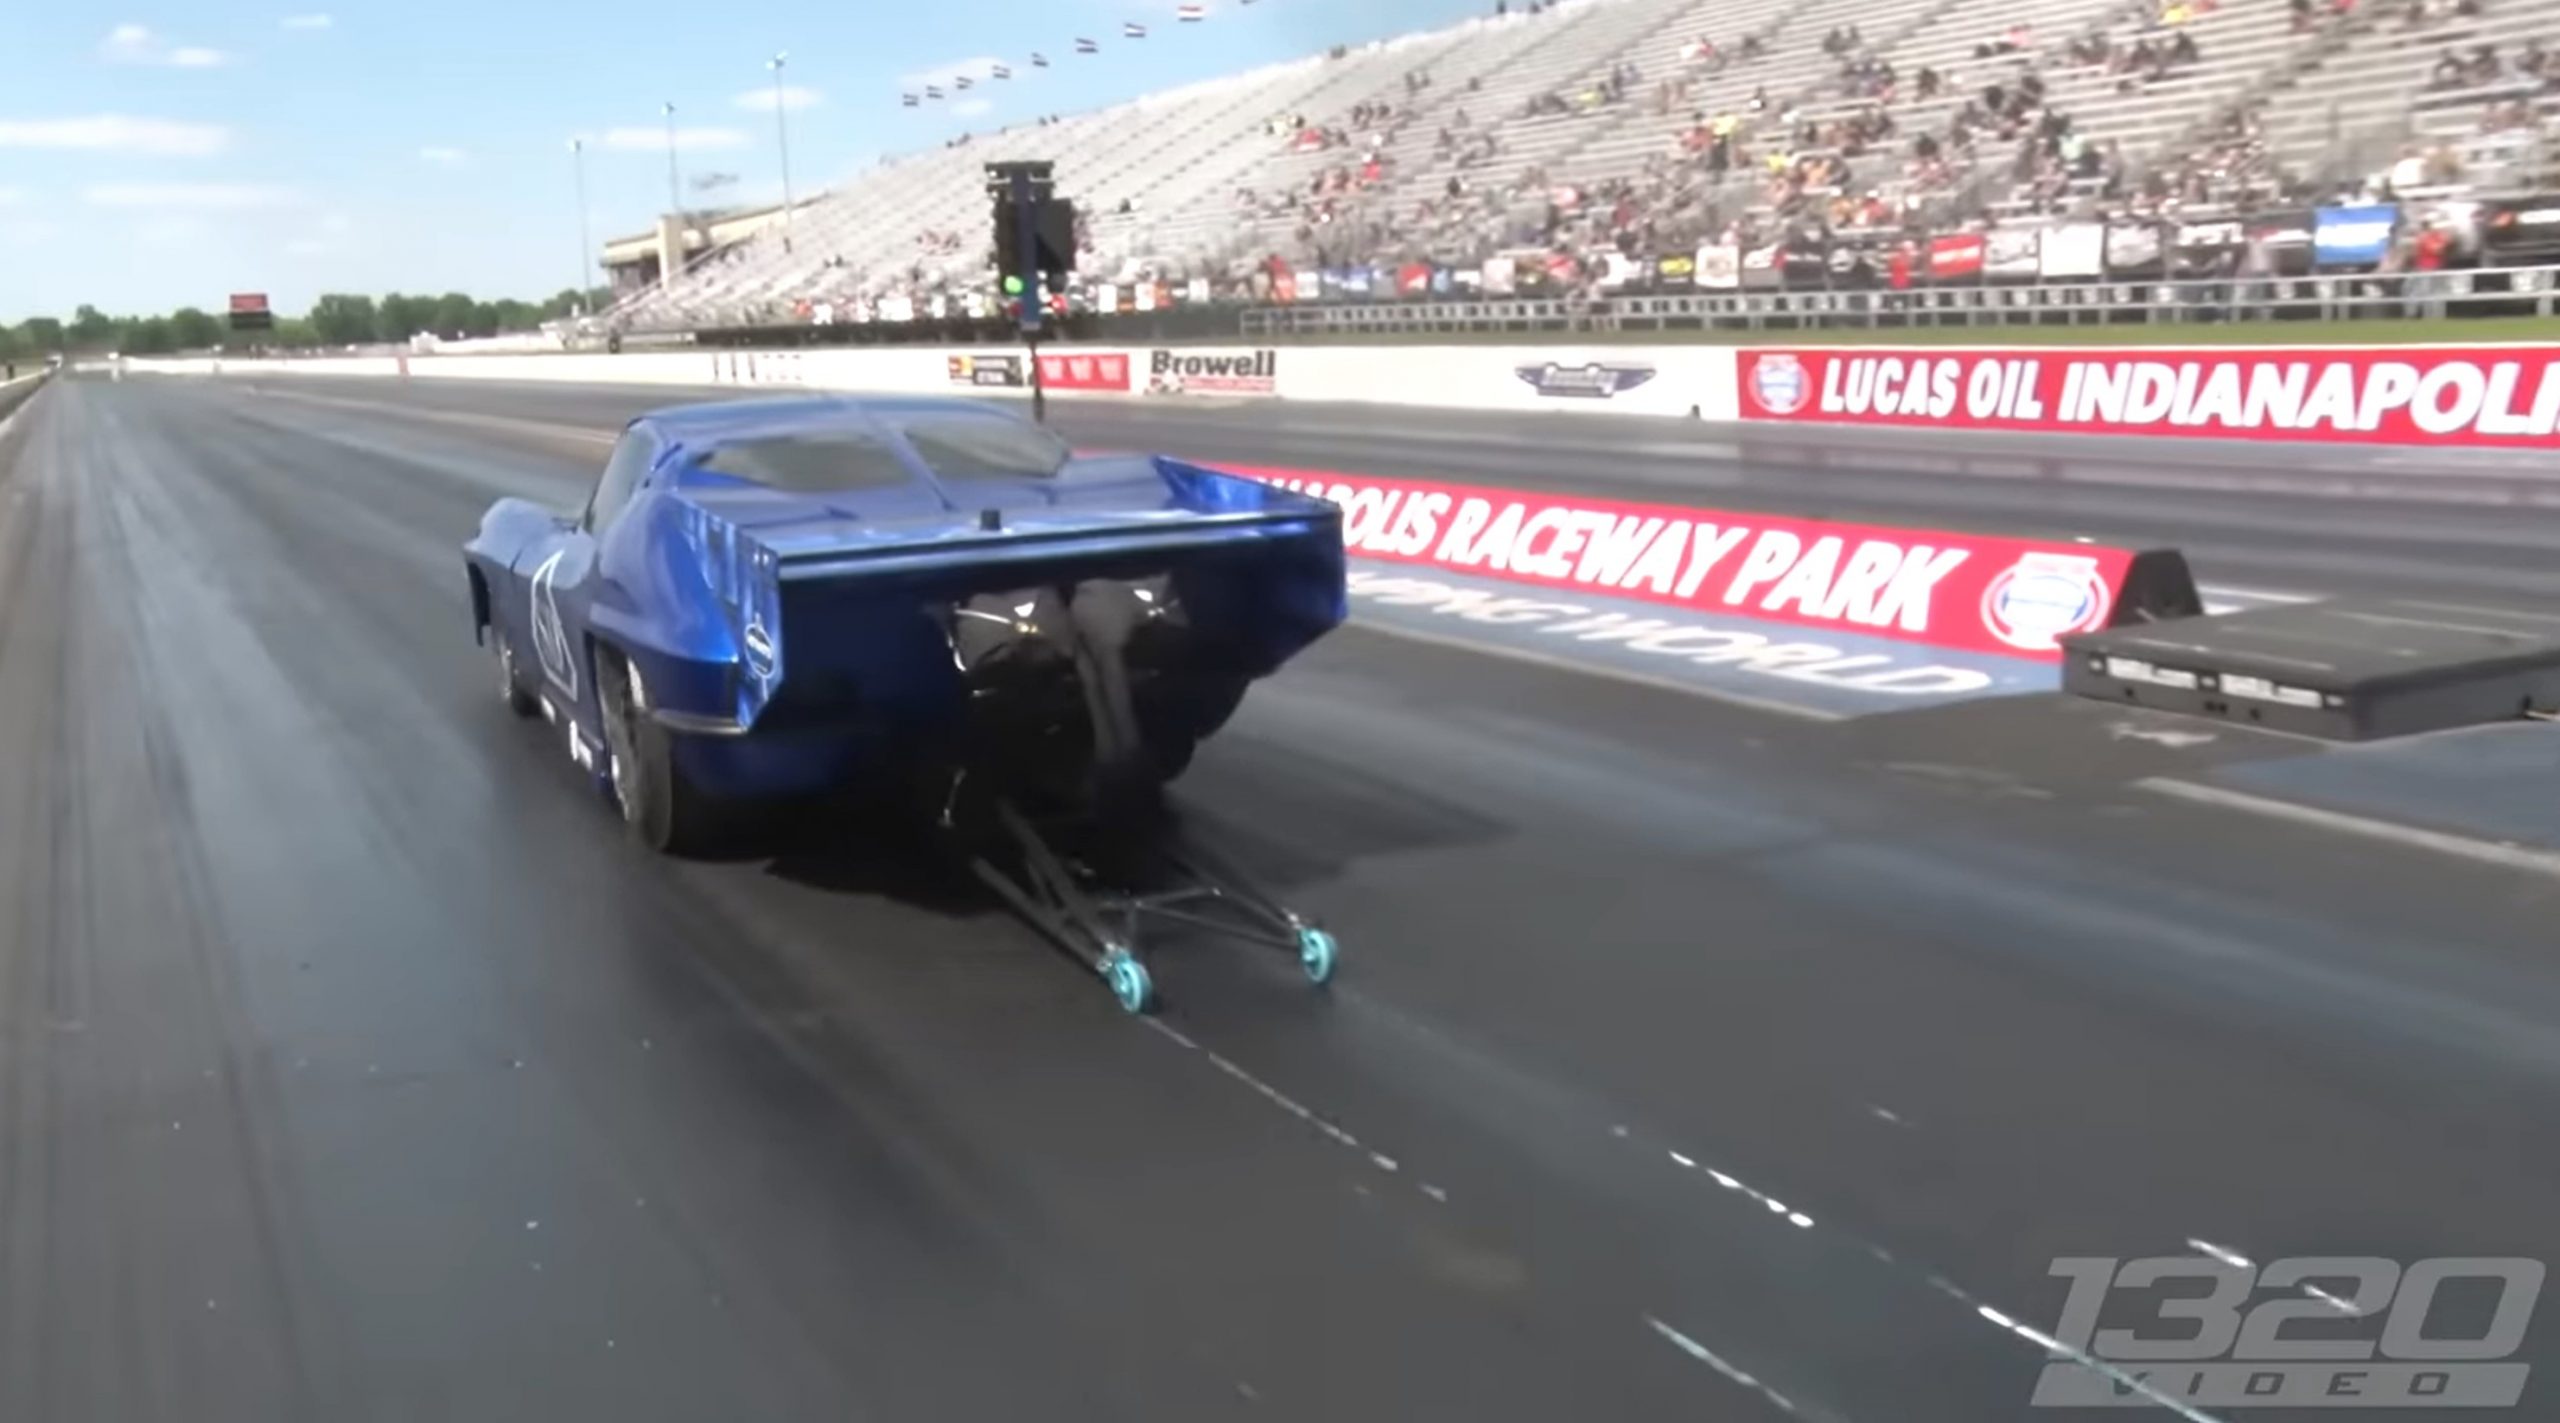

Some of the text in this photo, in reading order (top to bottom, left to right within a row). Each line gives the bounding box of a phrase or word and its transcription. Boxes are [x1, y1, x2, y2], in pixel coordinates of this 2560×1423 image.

[1150, 350, 1276, 378] Browell
[1820, 357, 1961, 419] LUCAS
[1966, 358, 2043, 420] OIL
[2056, 360, 2560, 435] INDIANAPOLI
[1434, 497, 1749, 600] RACEWAY
[1722, 530, 1971, 632] PARK
[1537, 612, 1993, 693] WORLD
